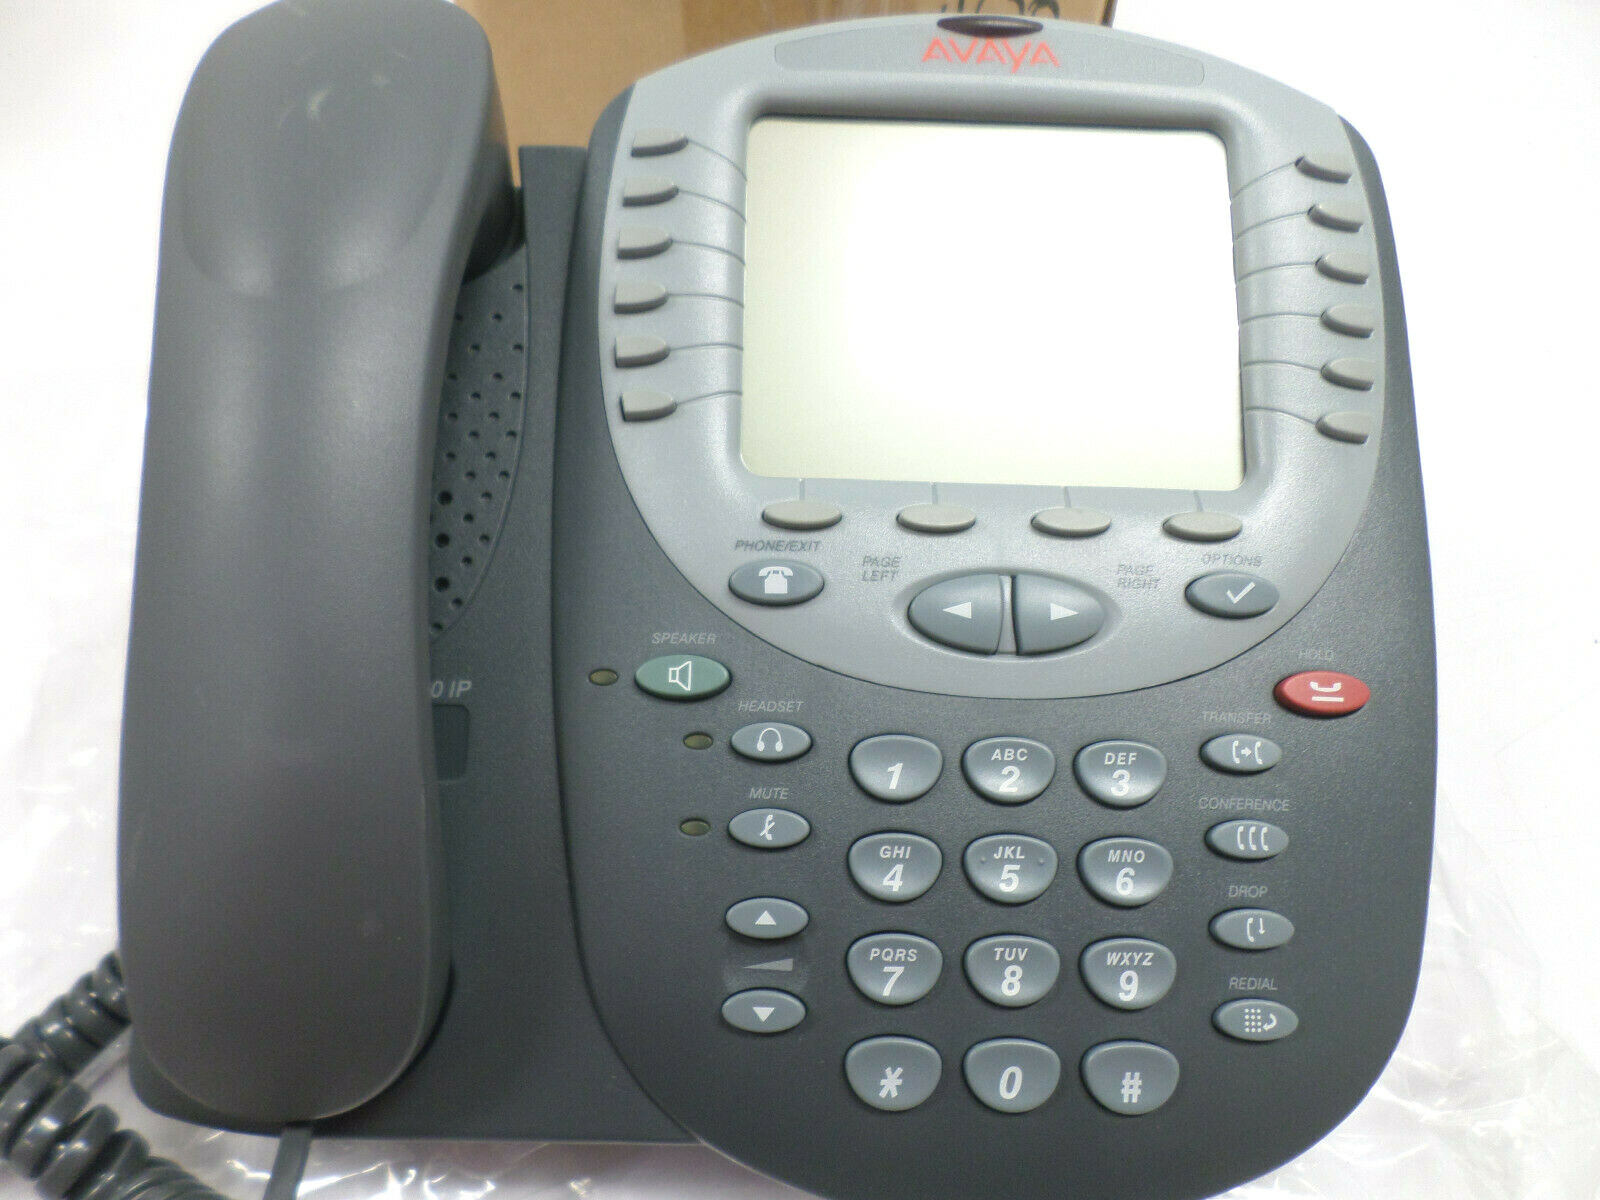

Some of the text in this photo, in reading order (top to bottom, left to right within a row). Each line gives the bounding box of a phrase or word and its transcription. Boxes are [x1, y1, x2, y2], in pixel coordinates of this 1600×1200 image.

[921, 36, 1061, 74] AVAYA
[734, 538, 821, 554] PHONE/EXIT
[862, 555, 902, 568] PAGE
[1201, 553, 1263, 568] OPTIONS
[861, 569, 900, 581] LEFT
[1117, 563, 1155, 576] PAGE
[1117, 577, 1161, 590] RIGHT
[651, 631, 717, 646] SPEAKER
[449, 680, 473, 699] IP
[738, 699, 804, 714] HEADSET
[1202, 710, 1272, 725] TRANSFER
[991, 748, 1029, 762] ABC
[1104, 752, 1138, 766] DEF
[886, 762, 904, 790] 1
[999, 765, 1021, 793] 2
[1110, 769, 1131, 797] 3
[749, 786, 790, 801] MUTE
[1199, 797, 1291, 812] CONFERENCE
[879, 845, 911, 860] GHI
[993, 846, 1026, 860] JKL
[1107, 849, 1146, 864] MNO
[882, 864, 904, 893] 4
[1000, 864, 1021, 893] 5
[1115, 867, 1136, 896] 6
[1228, 885, 1269, 899] DROP
[869, 947, 918, 962] PQRS
[994, 947, 1028, 962] TUV
[1105, 951, 1155, 967] WXYZ
[881, 965, 905, 997] 7
[1000, 965, 1023, 997] 8
[1118, 970, 1140, 1002] 9
[1228, 977, 1279, 991] REDIAL
[1000, 1065, 1023, 1100] 0
